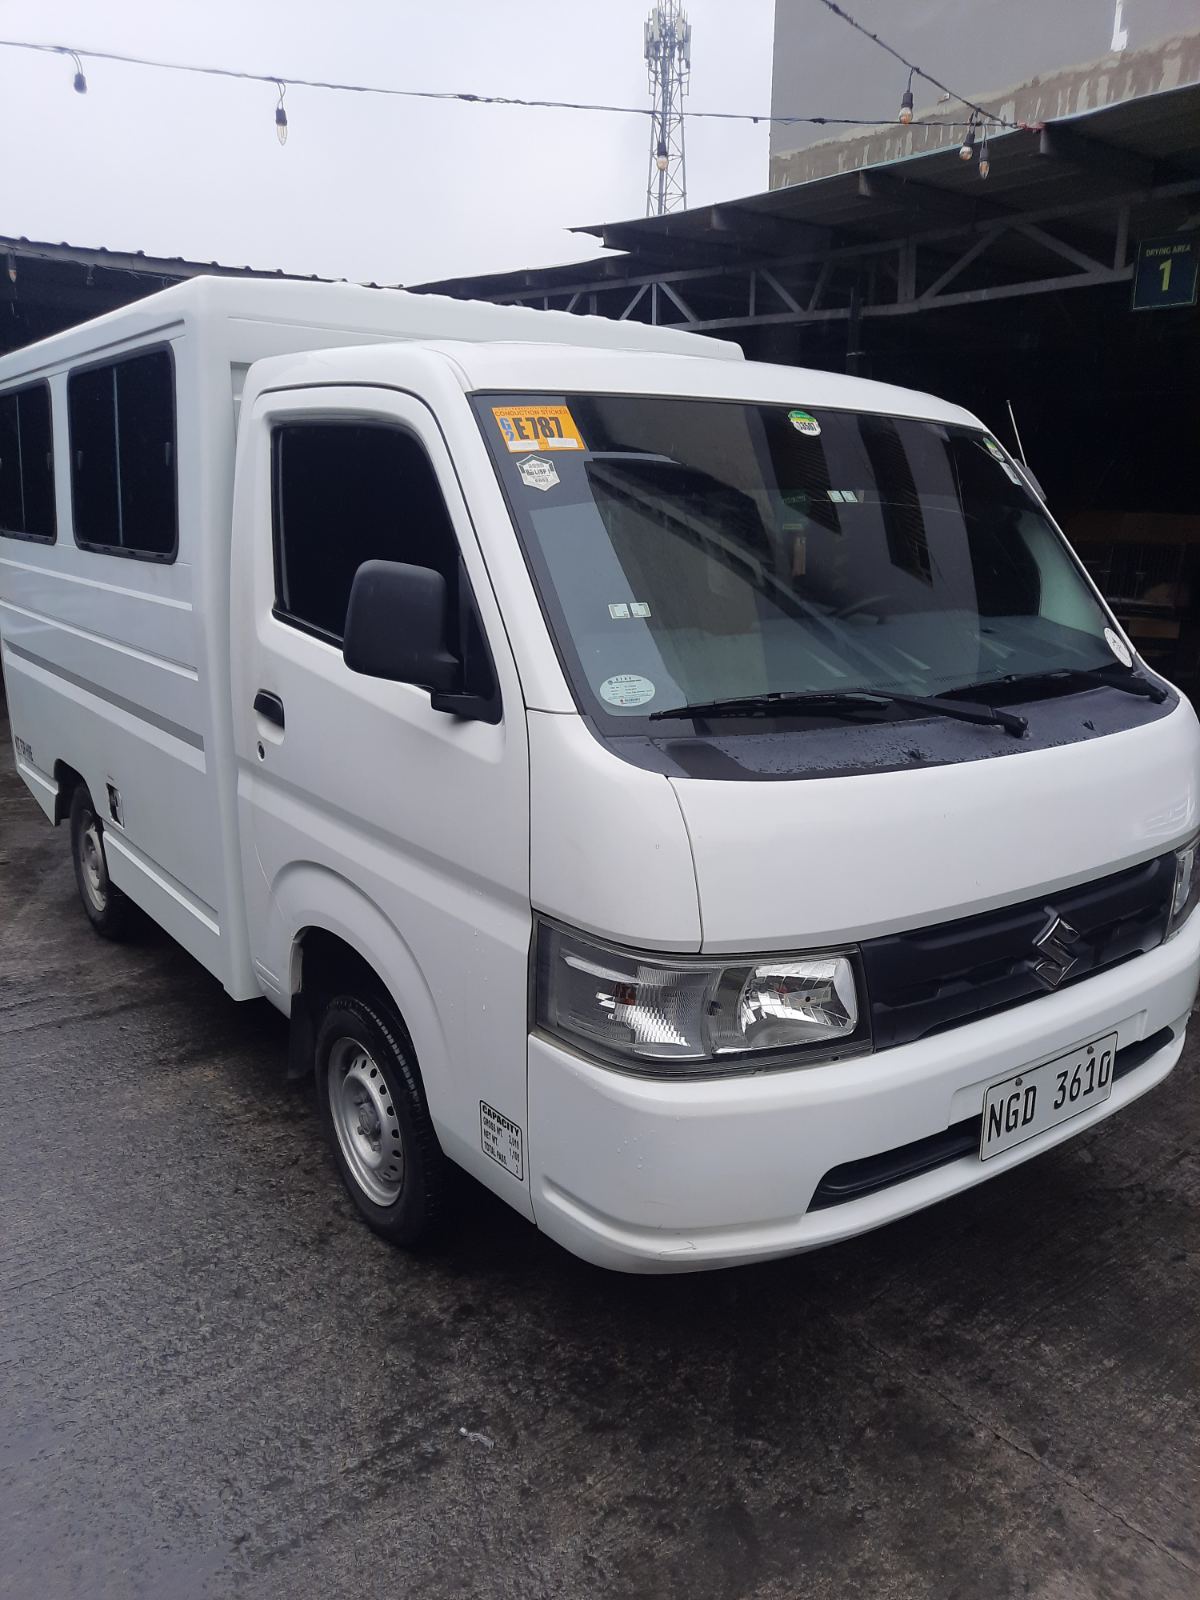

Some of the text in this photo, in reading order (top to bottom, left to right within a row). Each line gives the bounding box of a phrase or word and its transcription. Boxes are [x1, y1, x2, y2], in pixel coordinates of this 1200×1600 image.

[1145, 243, 1192, 257] DRYING AREA
[1159, 258, 1172, 292] 1
[495, 407, 568, 417] CONDUCTION STICKER
[511, 416, 564, 440] E787
[988, 1050, 1111, 1142] NGD 3610
[482, 1104, 519, 1137] CAPACITY
